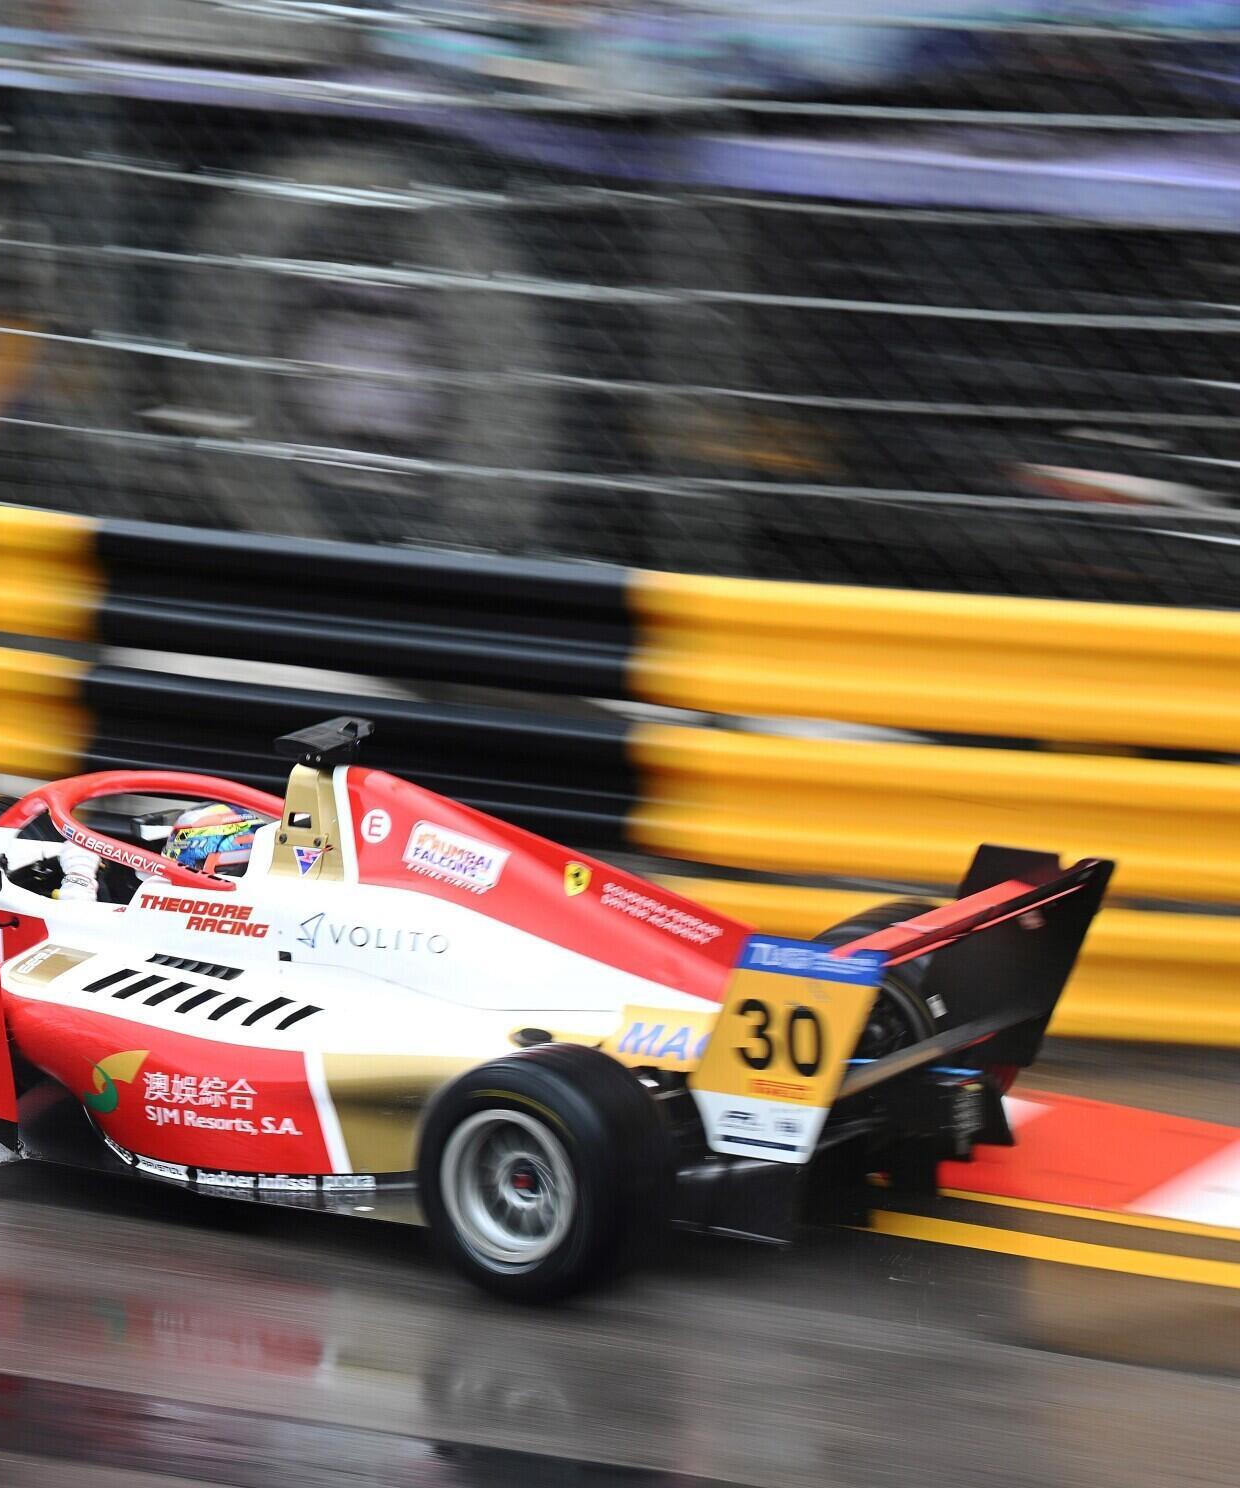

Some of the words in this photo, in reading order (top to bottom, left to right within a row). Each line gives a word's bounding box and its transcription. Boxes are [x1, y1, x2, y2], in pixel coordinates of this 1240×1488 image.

[368, 816, 384, 837] E
[140, 894, 253, 921] THEODORE
[185, 917, 270, 939] RACING
[329, 924, 449, 954] VOLITO
[732, 998, 823, 1078] 30
[144, 1105, 181, 1126] SJM
[183, 1109, 259, 1135] Resorts,
[261, 1116, 303, 1136] S.A.
